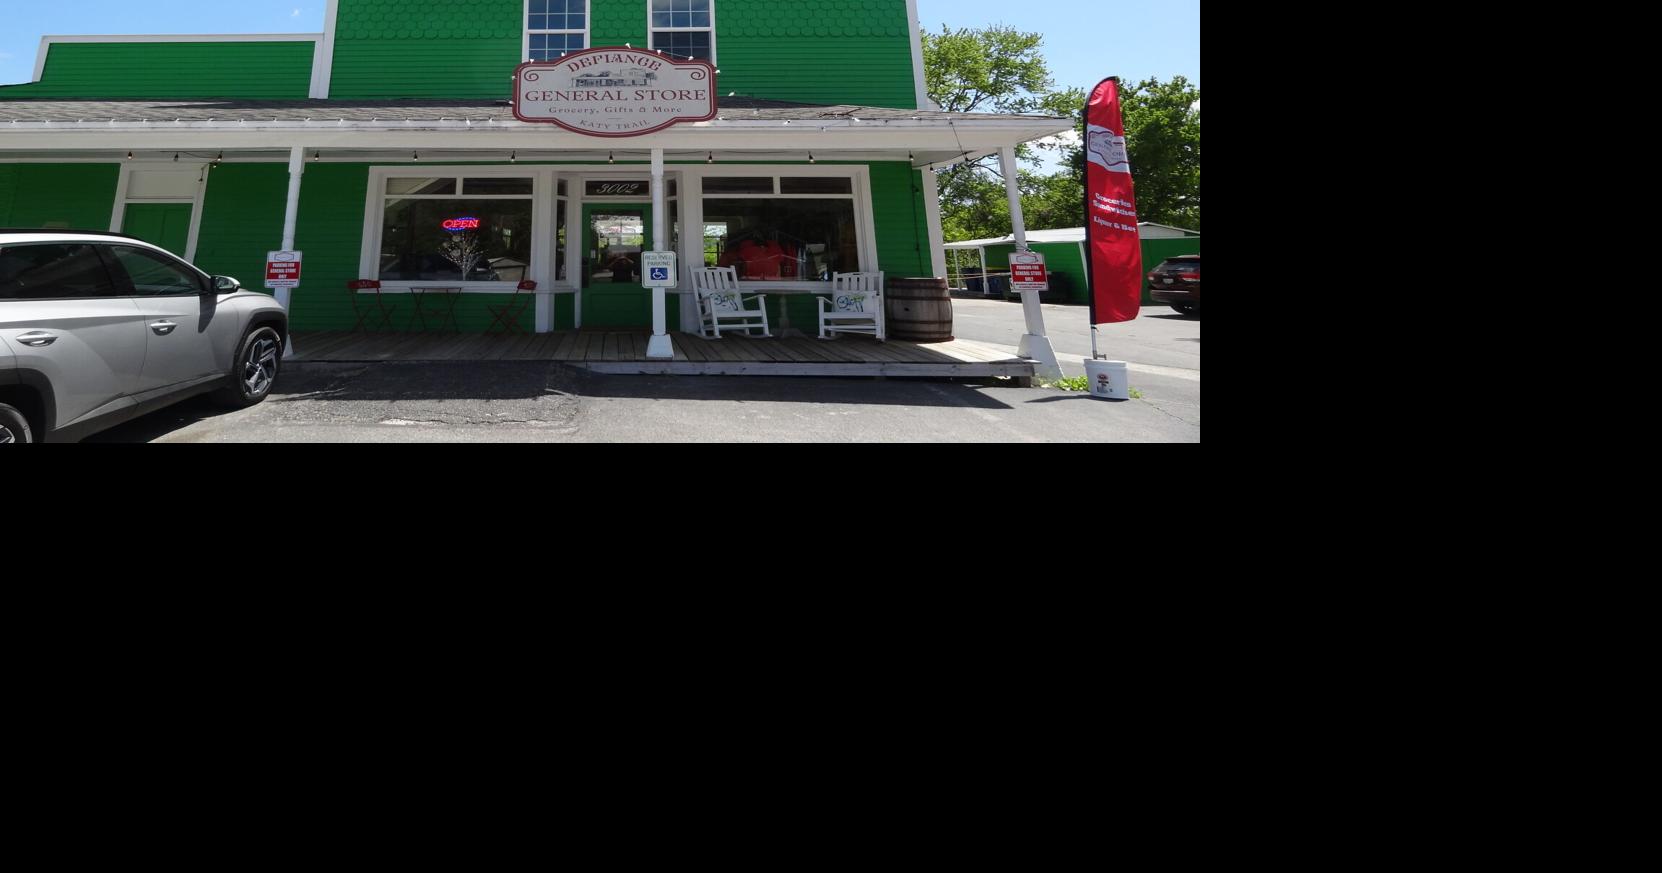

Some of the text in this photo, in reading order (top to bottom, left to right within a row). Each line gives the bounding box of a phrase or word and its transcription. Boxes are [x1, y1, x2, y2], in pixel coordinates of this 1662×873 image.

[567, 54, 662, 73] DEFIANCE
[525, 89, 706, 102] GENERAL STORE
[549, 106, 600, 114] Grocery,
[579, 119, 650, 130] KATY TRAIL
[596, 183, 640, 193] 3002
[442, 219, 480, 229] OPEN
